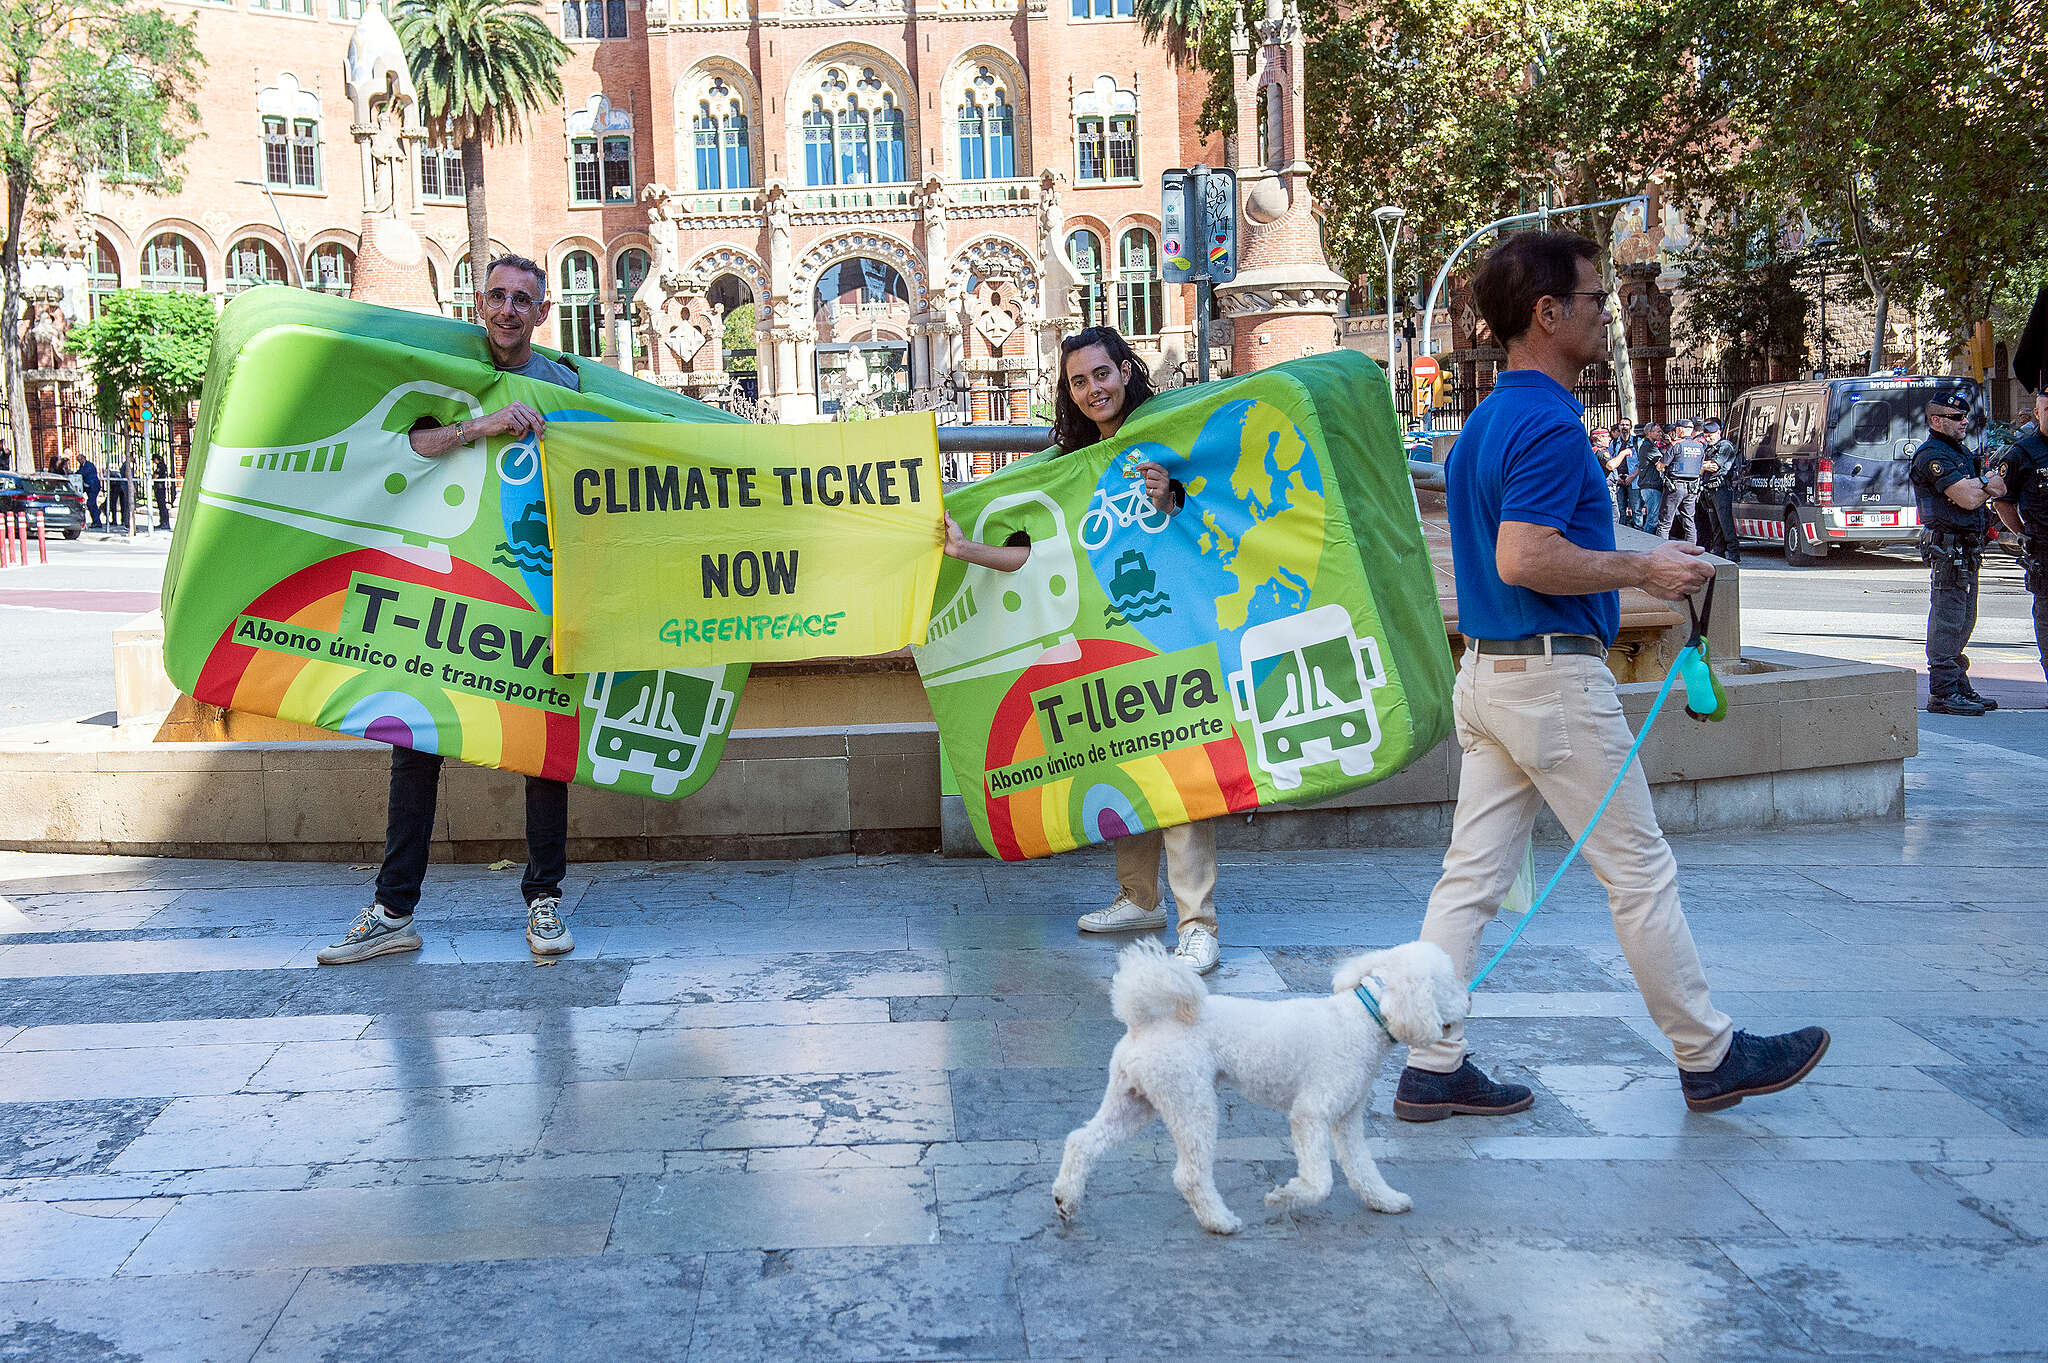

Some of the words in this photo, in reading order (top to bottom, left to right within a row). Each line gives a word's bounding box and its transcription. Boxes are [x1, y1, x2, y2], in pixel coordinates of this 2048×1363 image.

[1870, 381, 1907, 390] brigada
[573, 465, 761, 515] CLIMATE
[773, 457, 923, 507] TICKET
[1861, 494, 1880, 502] E-40
[701, 550, 799, 598] NOW
[658, 611, 846, 647] GREENPEACE
[237, 620, 321, 652] Abono
[329, 636, 397, 669] único
[404, 655, 434, 677] de
[441, 663, 571, 708] transporte
[1037, 667, 1219, 744] T-lleva
[990, 764, 1043, 791] Abono
[1047, 751, 1085, 776] único
[1088, 744, 1107, 764] de
[1109, 717, 1223, 758] transporte
